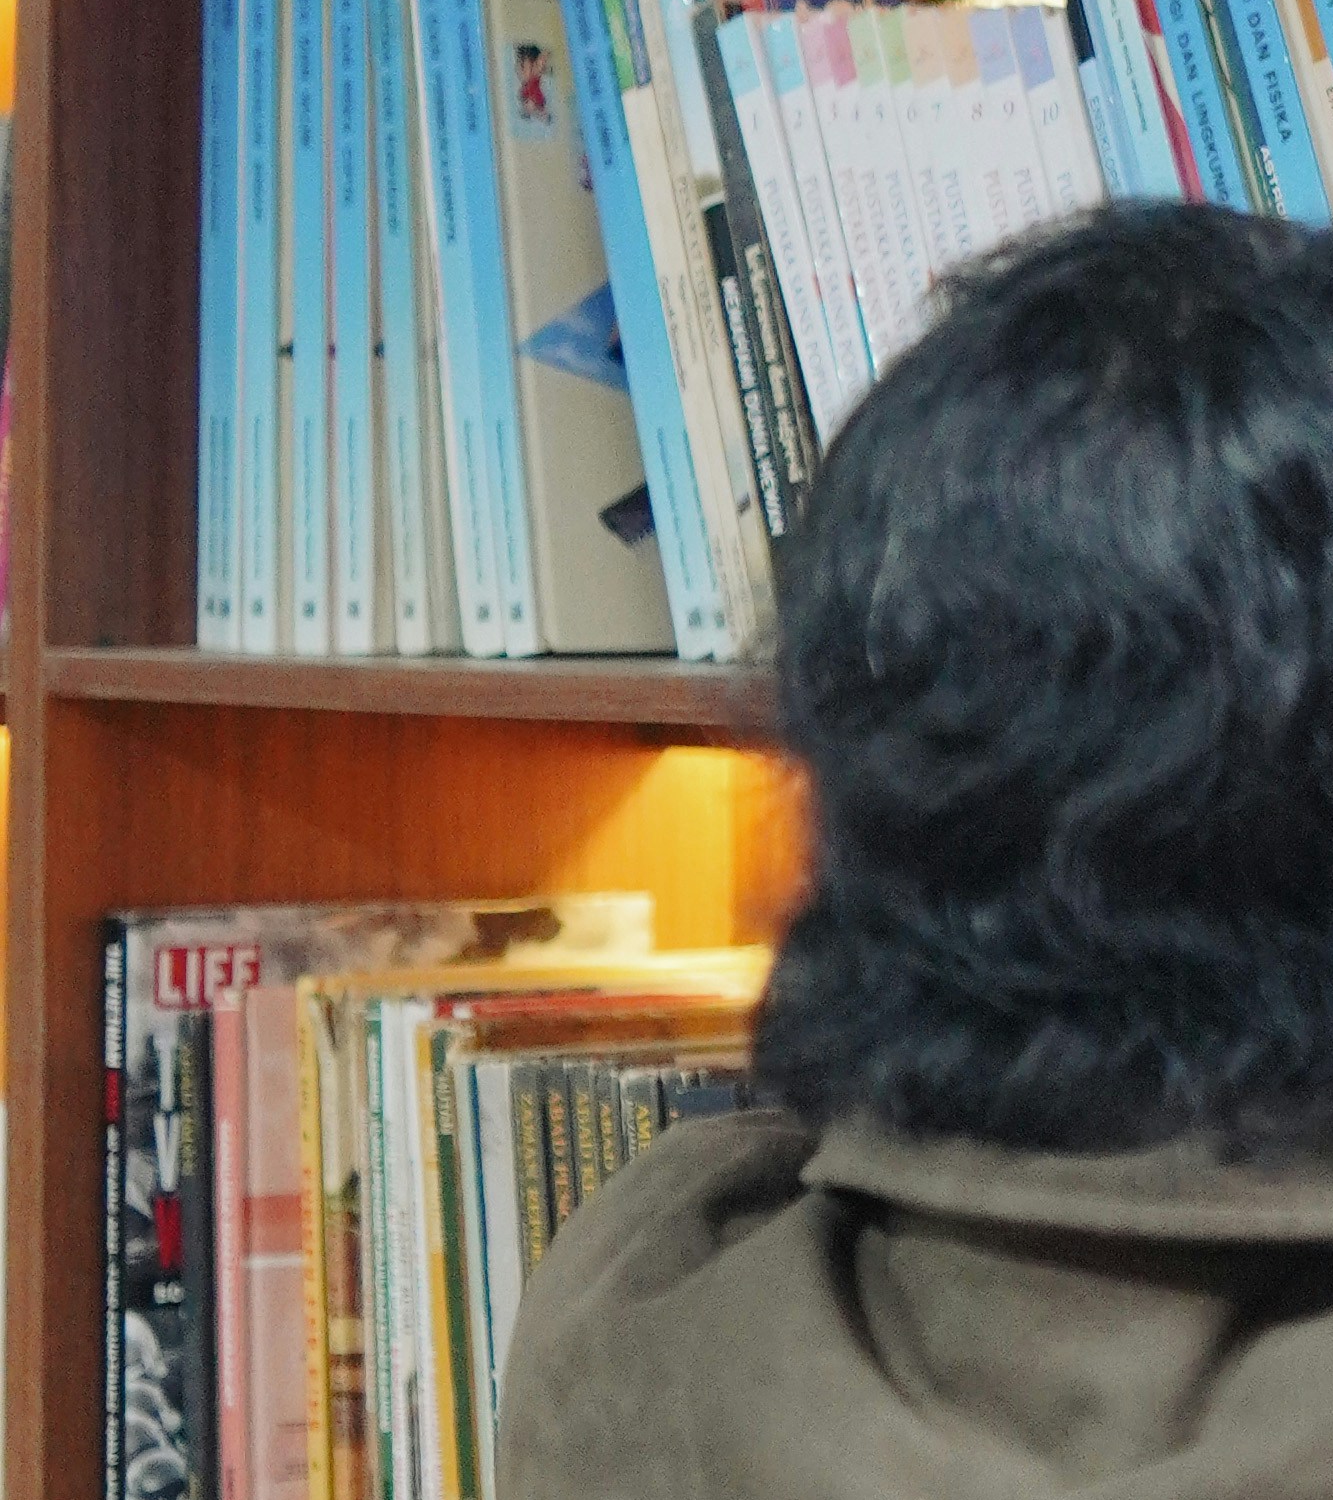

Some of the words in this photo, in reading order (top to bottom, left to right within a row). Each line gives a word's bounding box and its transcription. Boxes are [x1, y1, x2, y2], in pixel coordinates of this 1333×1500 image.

[1178, 32, 1197, 82] DAN
[1247, 12, 1270, 62] DAN
[1264, 70, 1294, 144] FISIKA
